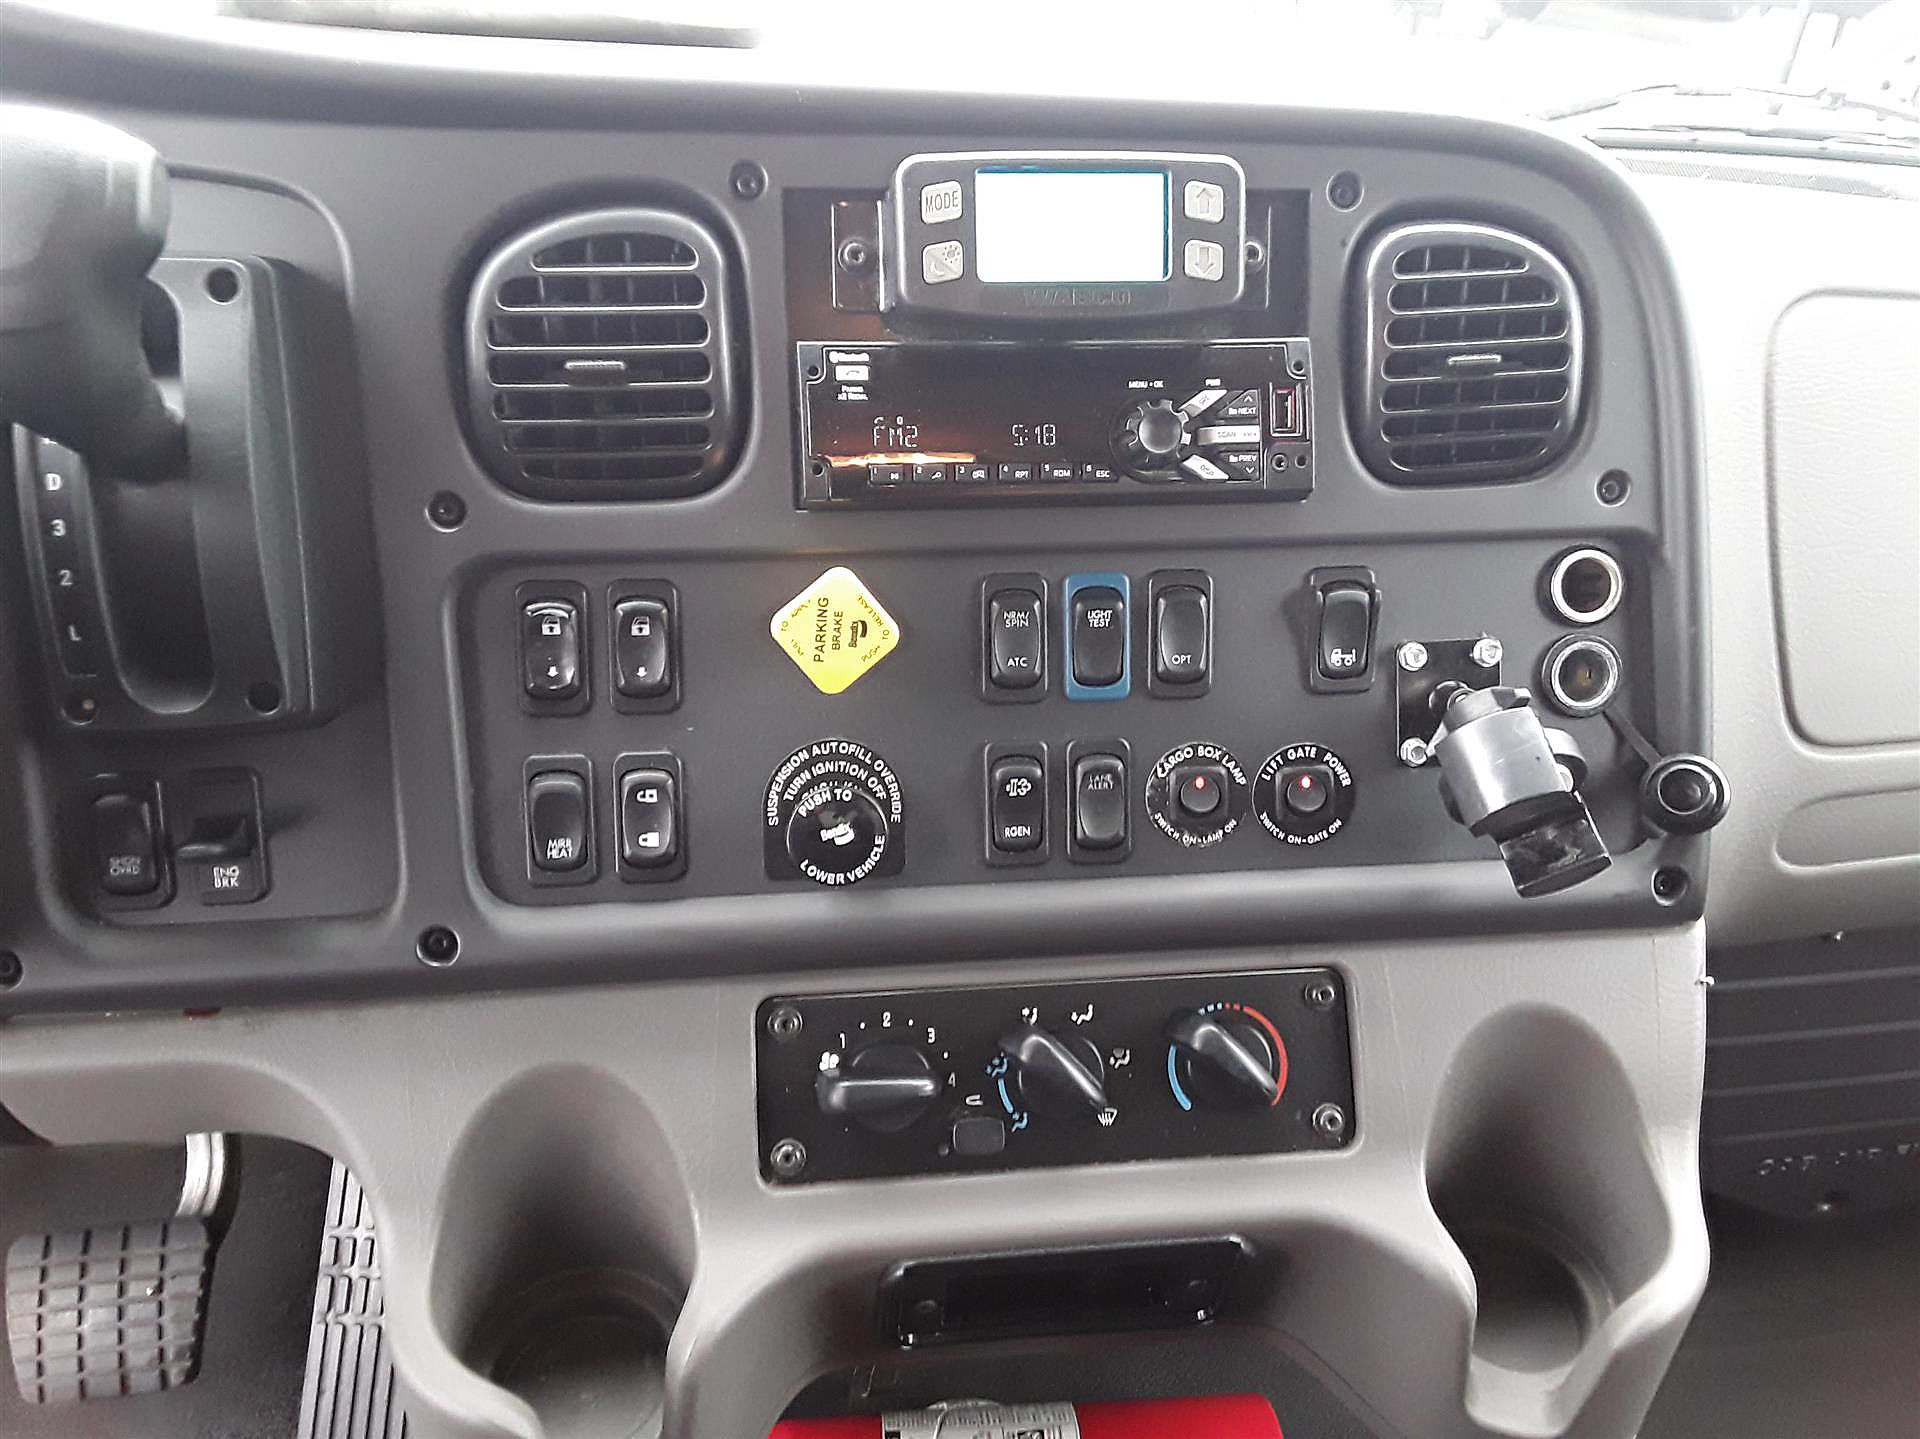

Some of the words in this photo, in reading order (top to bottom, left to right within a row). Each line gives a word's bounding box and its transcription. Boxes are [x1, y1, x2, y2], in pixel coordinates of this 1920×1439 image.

[924, 190, 960, 213] MODE
[1153, 380, 1164, 388] OK
[873, 424, 918, 447] FM2
[1011, 424, 1056, 447] 5:18
[44, 473, 63, 490] D
[1014, 470, 1029, 479] RPT
[1095, 470, 1110, 478] ESC
[50, 519, 67, 537] 3
[58, 569, 73, 586] 2
[1005, 618, 1030, 628] SPIN
[1087, 609, 1113, 620] LIGHT
[1088, 618, 1111, 628] TEST
[69, 624, 82, 642] L
[813, 597, 829, 663] PARKING
[831, 611, 844, 650] BRAKE
[1007, 656, 1028, 667] ATC
[1171, 654, 1192, 665] OPT
[1156, 746, 1194, 778] CARGO
[1197, 745, 1222, 761] BOX
[1221, 754, 1248, 785] LAMP
[1261, 754, 1284, 781] LIFT
[1286, 746, 1317, 760] GATE
[1322, 751, 1352, 788] POWER
[766, 749, 810, 826] SUSPENSION
[811, 741, 873, 765] AUTOFILL
[873, 759, 902, 824] OVERRIDE
[783, 769, 812, 802] TURN
[811, 760, 868, 781] IGNITION
[867, 776, 887, 801] OFF
[797, 789, 832, 818] PUSH
[833, 788, 852, 802] TO
[1154, 812, 1180, 840] SWITCH
[1223, 818, 1238, 833] ON
[1259, 811, 1286, 840] SWITCH
[1328, 818, 1343, 834] ON
[547, 848, 572, 860] HEAT
[799, 858, 845, 885] LOWER
[846, 834, 885, 882] VEHICLE
[882, 1011, 891, 1028] 2
[839, 1032, 846, 1049] 1
[927, 1027, 936, 1044] 3
[947, 1071, 956, 1088] 4
